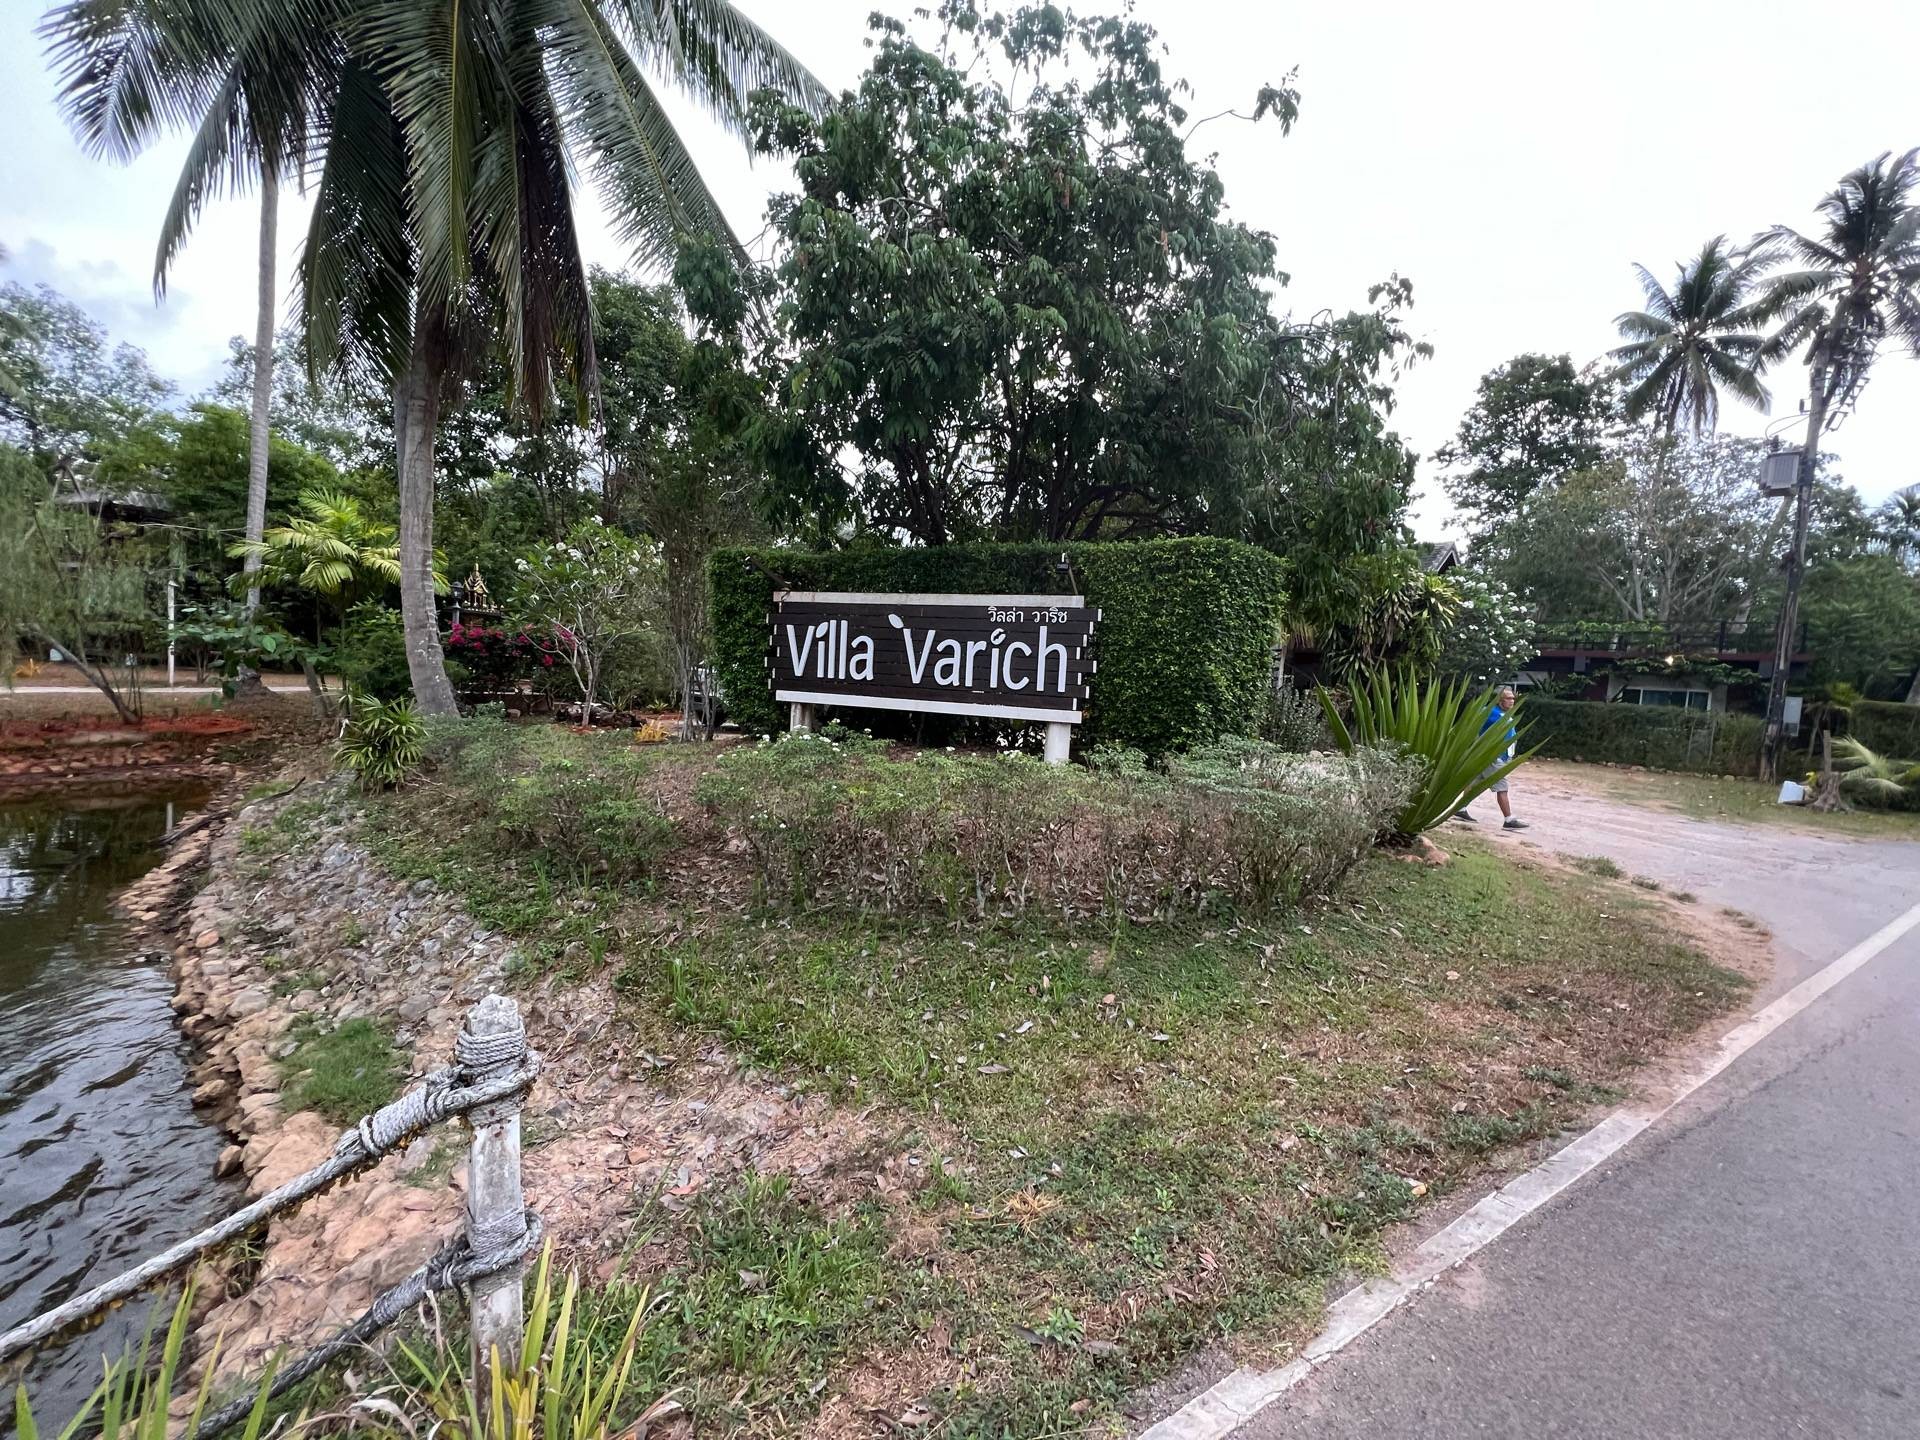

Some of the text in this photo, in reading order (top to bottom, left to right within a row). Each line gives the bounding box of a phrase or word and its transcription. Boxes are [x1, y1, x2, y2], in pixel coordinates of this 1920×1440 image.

[988, 606, 1068, 624] วิลล่า วาริช
[786, 619, 1068, 693] Villa Varich
